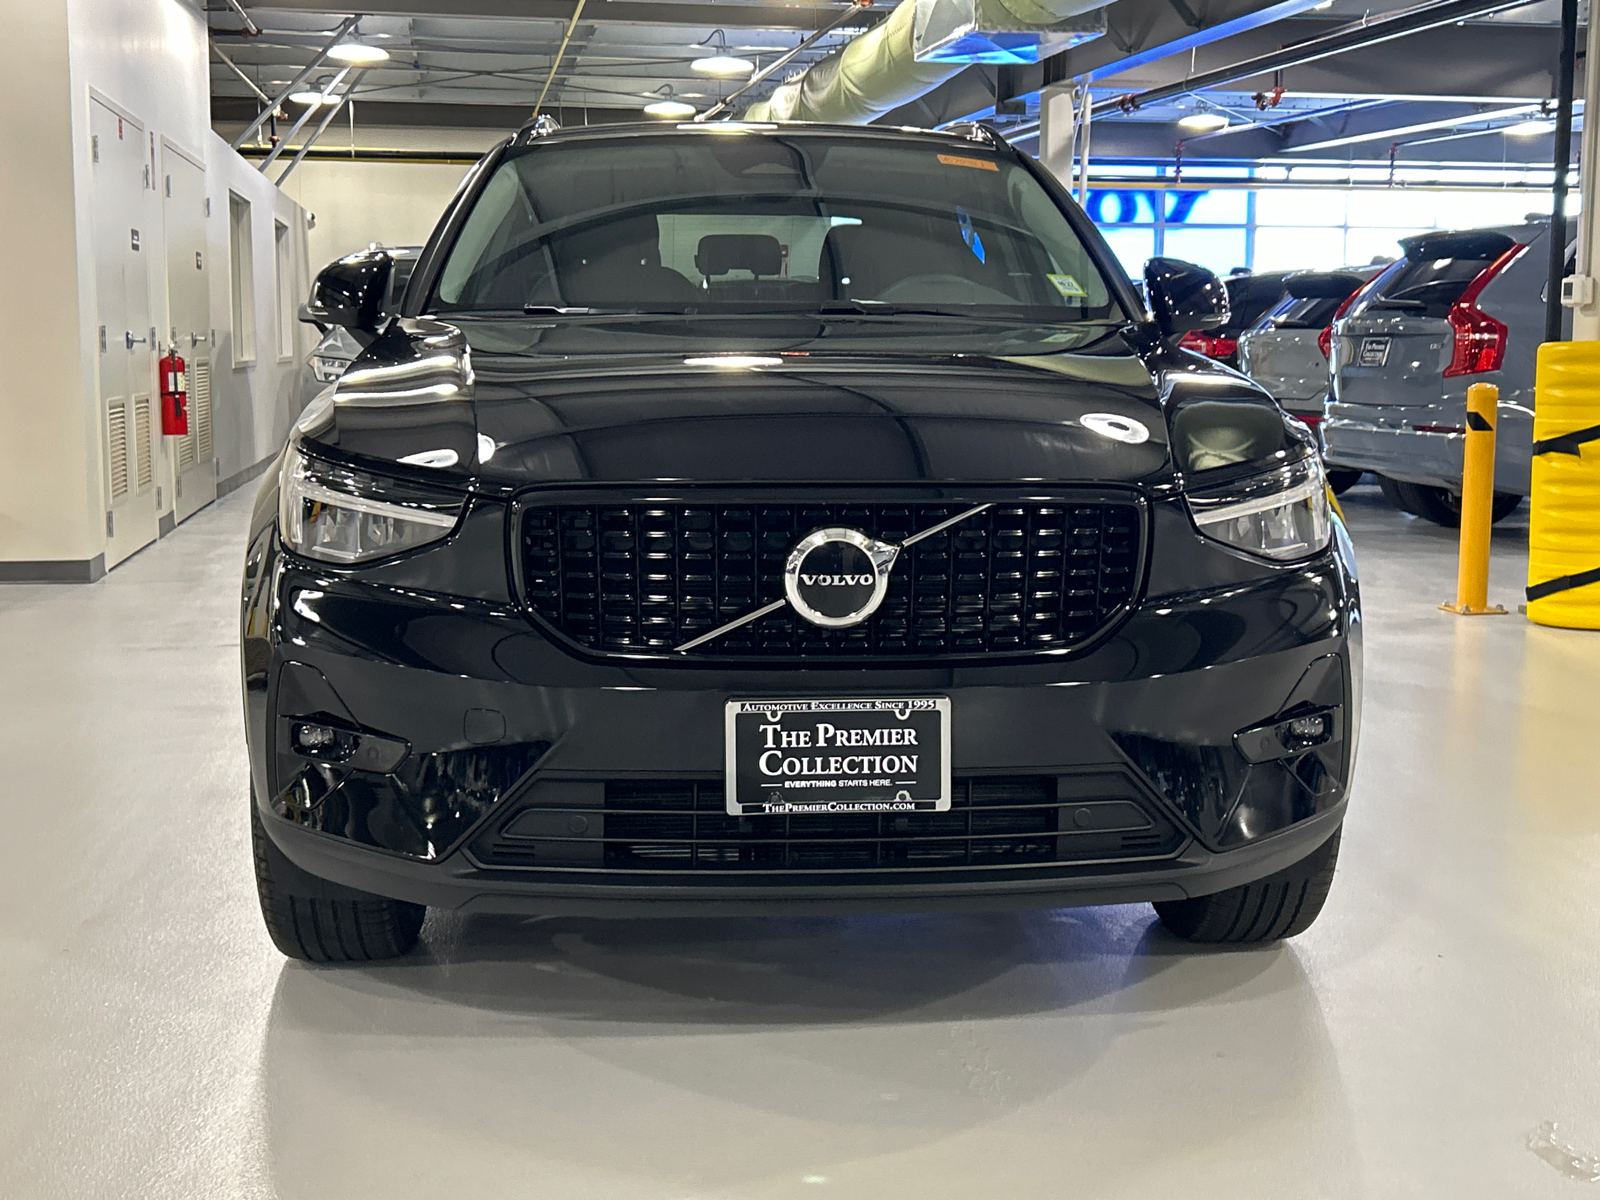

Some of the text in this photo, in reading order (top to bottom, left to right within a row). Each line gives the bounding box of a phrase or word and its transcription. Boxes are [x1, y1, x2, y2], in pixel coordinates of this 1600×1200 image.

[800, 573, 874, 586] VOLVO
[743, 702, 808, 711] AUTOMOTIVE
[875, 701, 905, 709] SINCE
[908, 700, 935, 709] 1995
[759, 723, 918, 748] THE PREMIER
[759, 750, 918, 776] COLLECTION
[784, 780, 837, 788] EVERYTHING
[838, 779, 868, 787] STARTS
